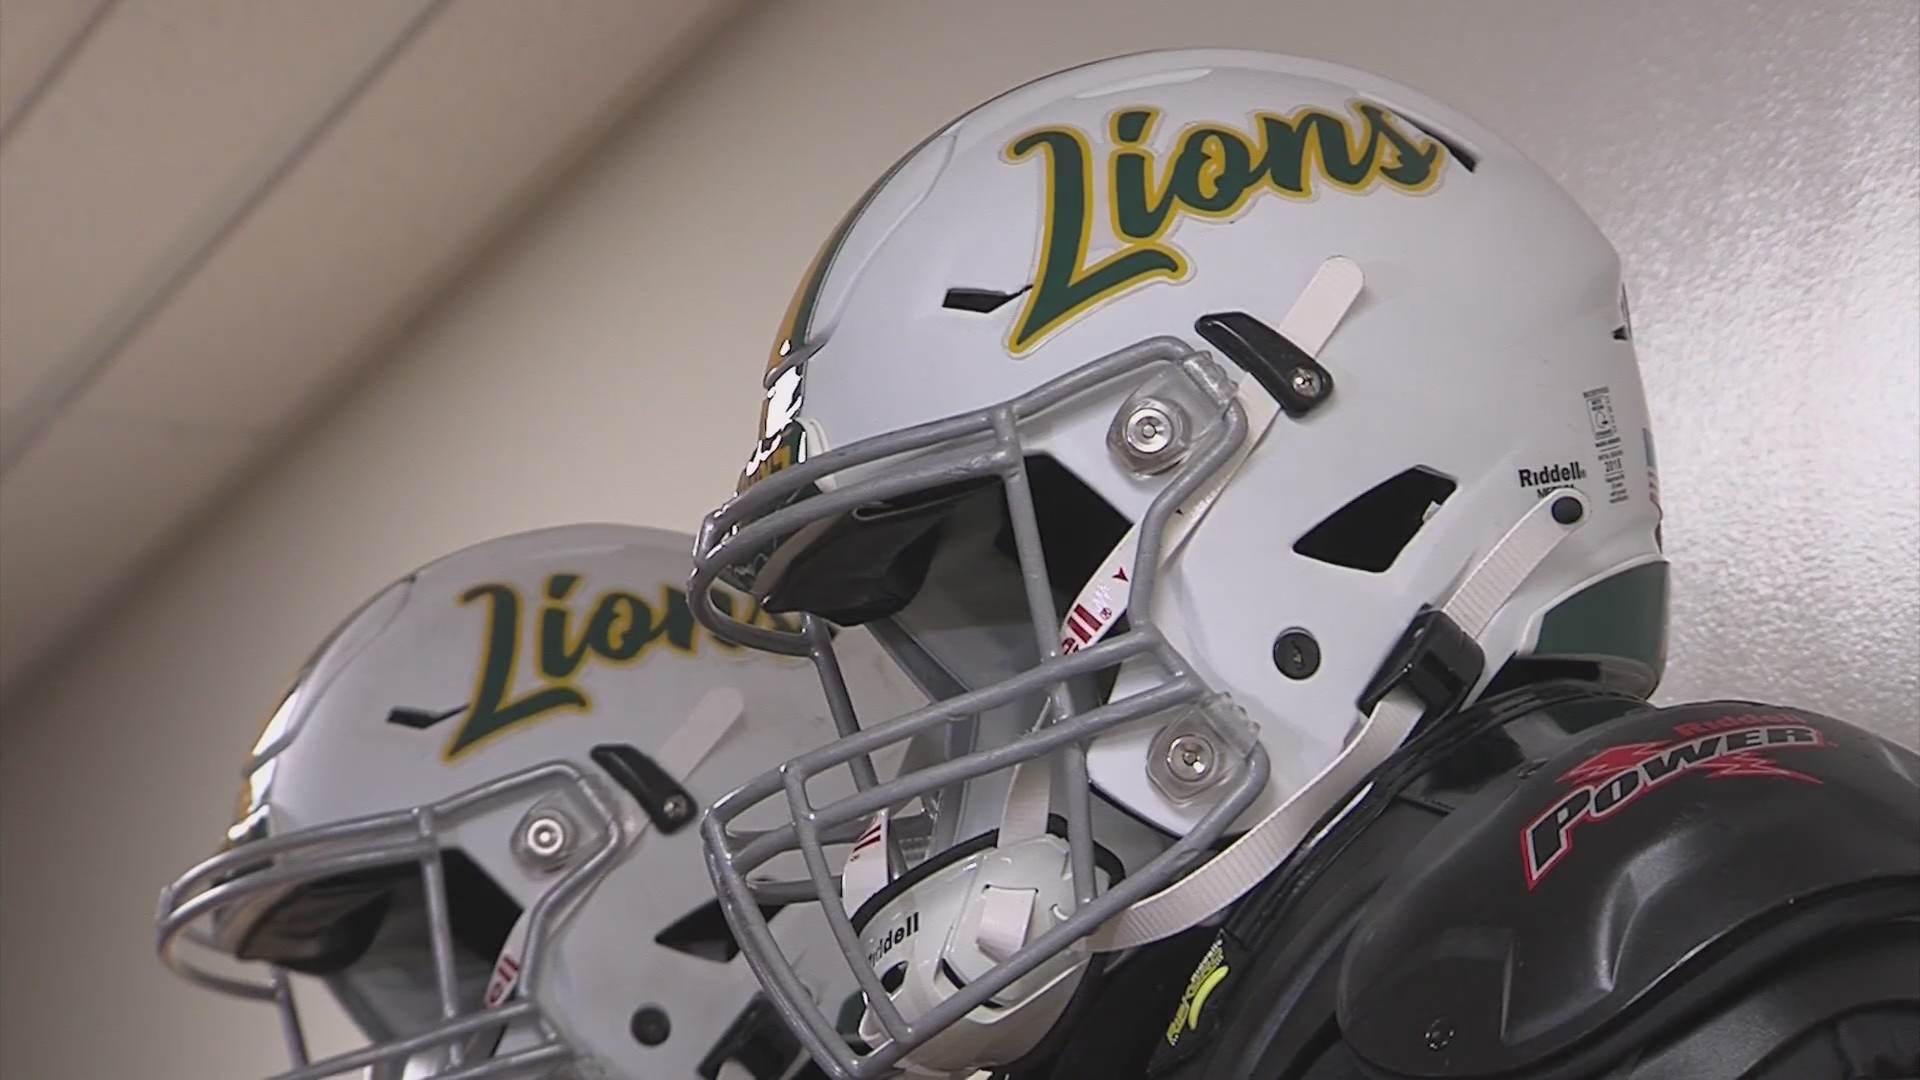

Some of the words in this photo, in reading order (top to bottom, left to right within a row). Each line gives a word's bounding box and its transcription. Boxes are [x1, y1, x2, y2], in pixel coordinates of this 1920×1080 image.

[1007, 100, 1446, 354] Lions
[1518, 461, 1582, 488] Riddell
[1521, 725, 1823, 889] POWER
